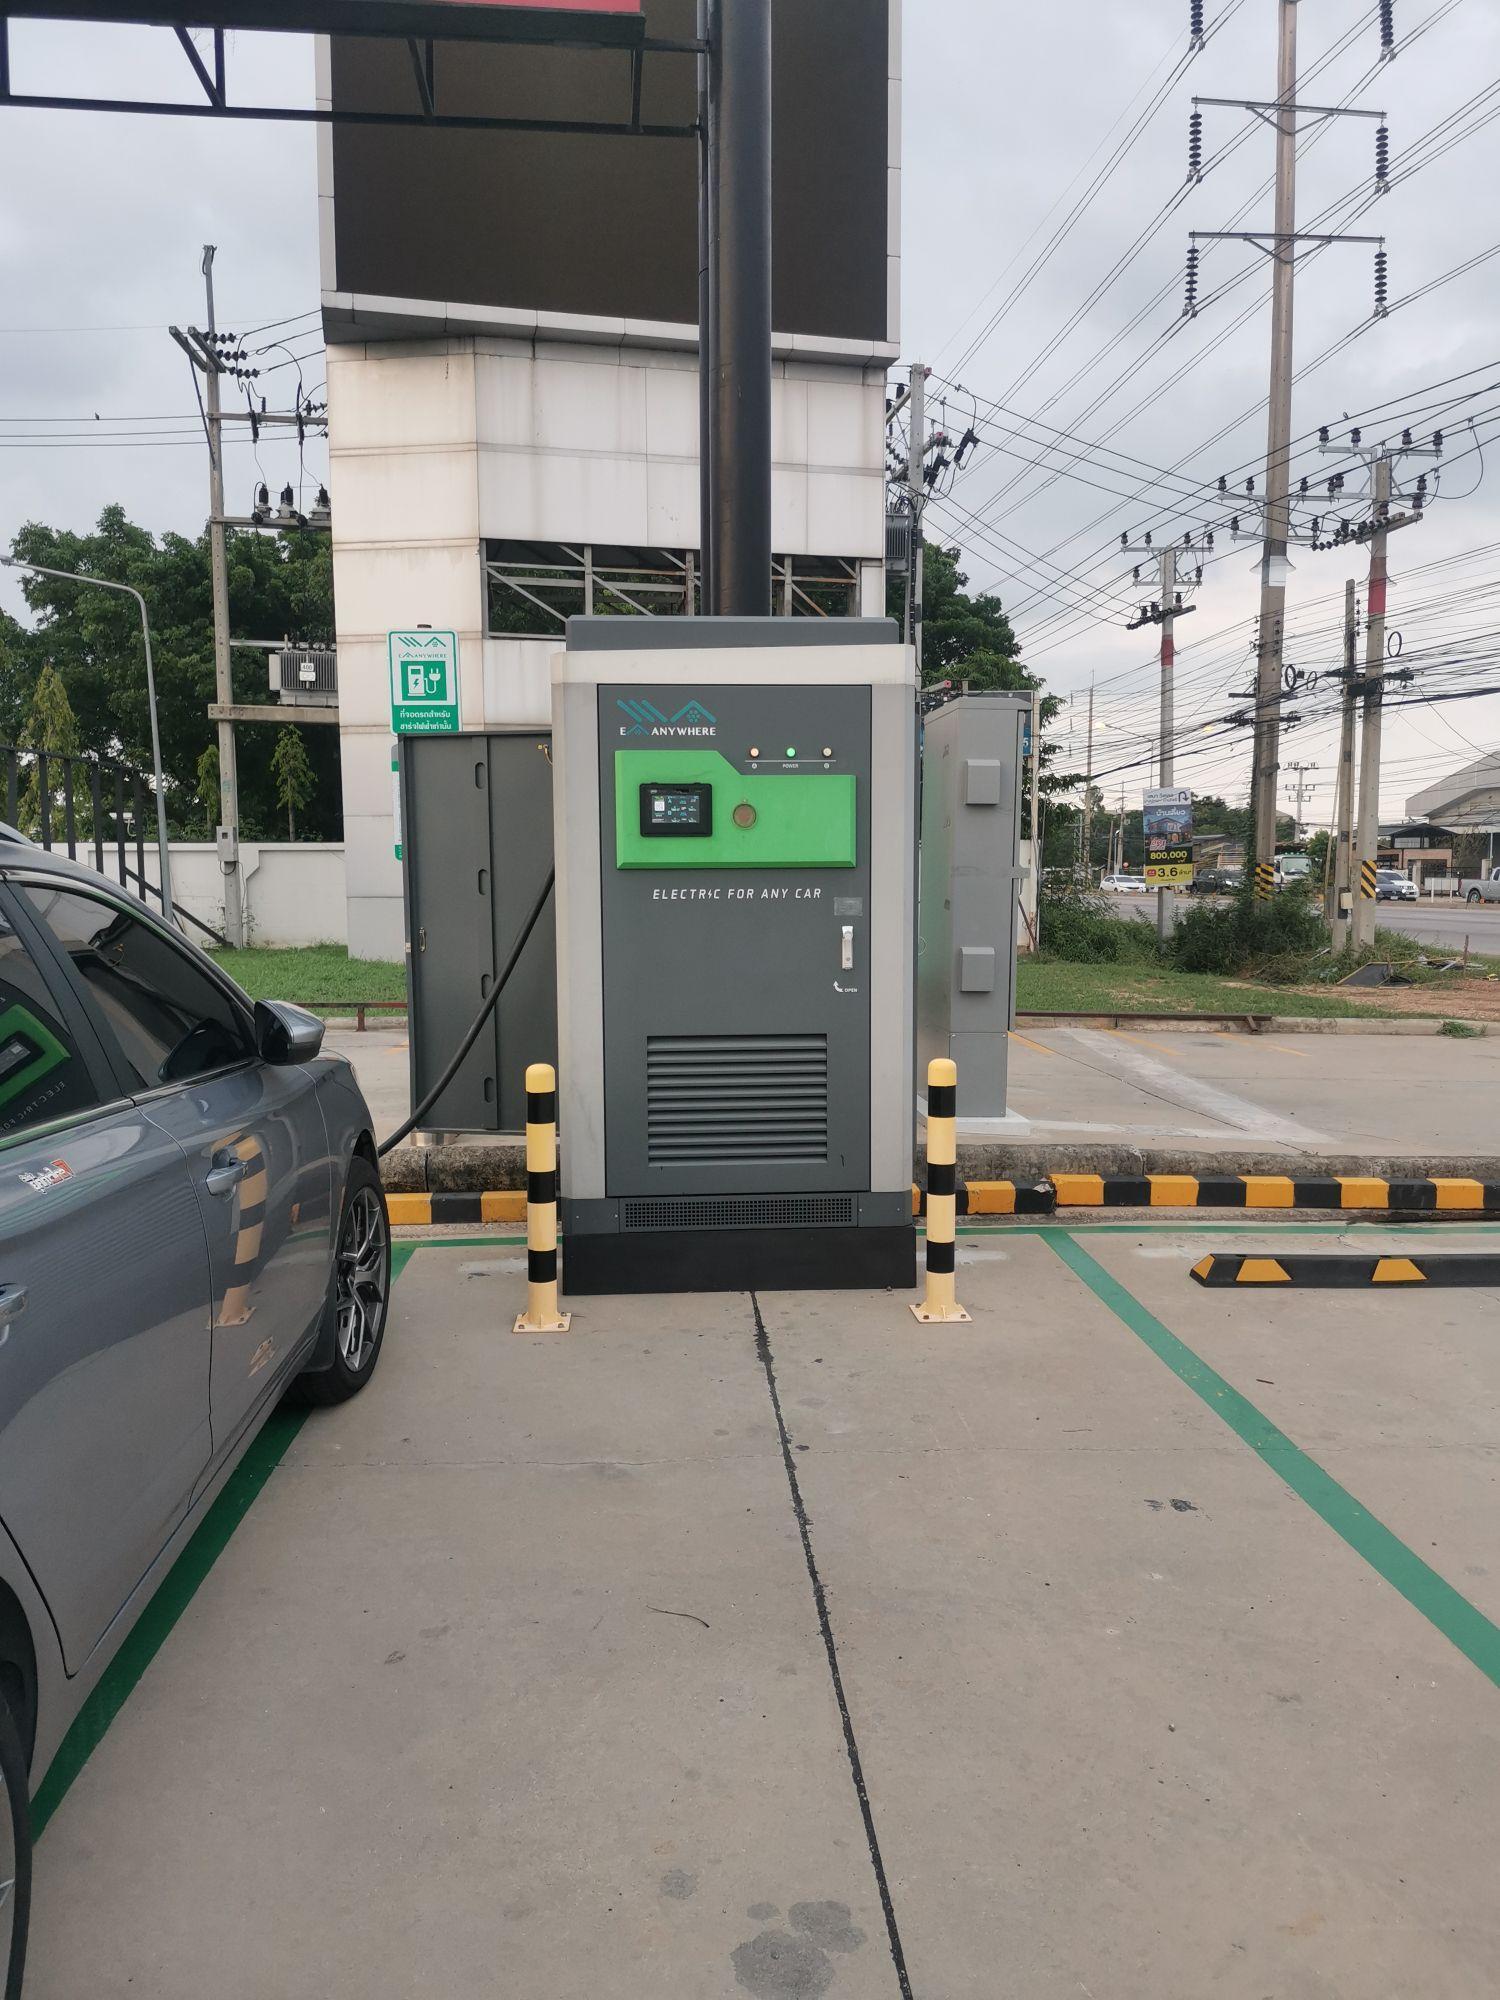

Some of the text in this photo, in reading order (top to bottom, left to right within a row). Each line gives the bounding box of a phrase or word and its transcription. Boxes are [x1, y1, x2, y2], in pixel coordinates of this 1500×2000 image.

[400, 708, 451, 718] ที่จอดรถสำหรับ
[400, 720, 452, 730] ชาร์จไฟฟ้าเท่านั้น
[651, 727, 717, 736] ANYWHERE
[1150, 851, 1188, 860] 800,000
[1158, 867, 1178, 878] 3.6
[652, 888, 822, 900] ELECTRIC FOR ANY CAR
